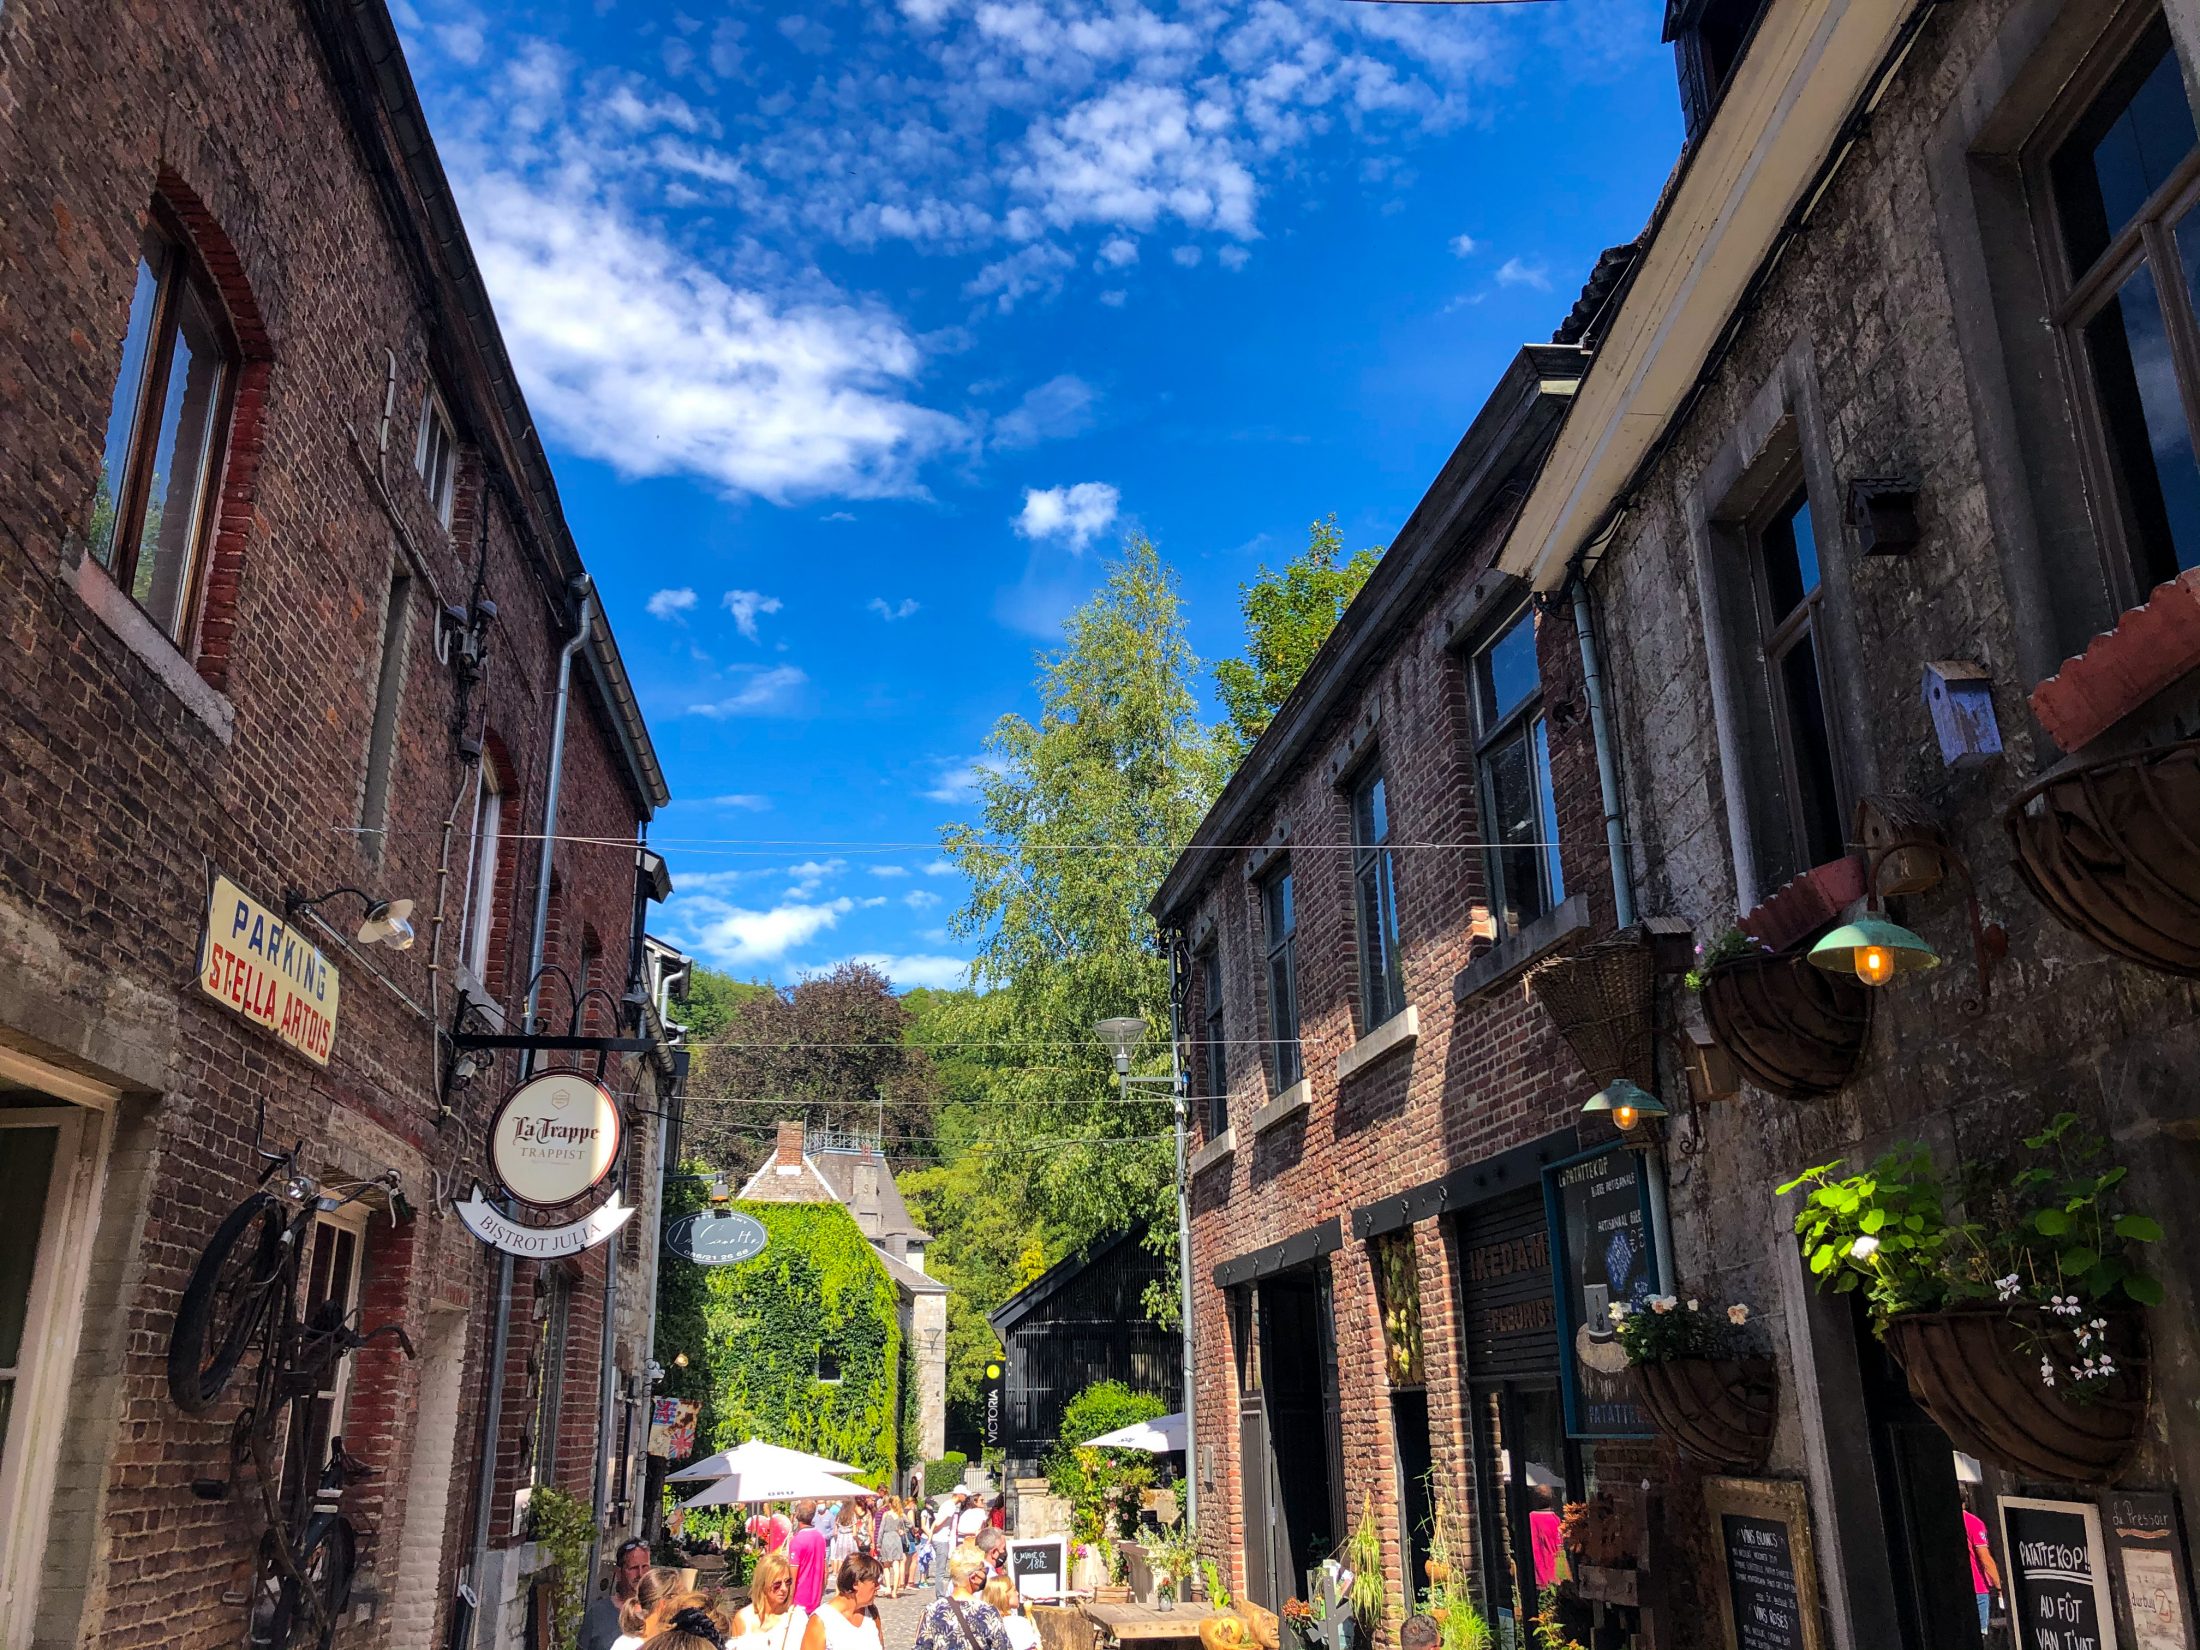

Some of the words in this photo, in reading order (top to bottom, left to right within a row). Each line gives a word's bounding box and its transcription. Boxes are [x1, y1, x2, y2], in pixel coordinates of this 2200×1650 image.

[232, 900, 326, 1001] PARKING
[209, 943, 276, 1023] STELLA
[280, 992, 331, 1058] ARTOIS
[512, 1116, 535, 1142] La
[536, 1117, 600, 1144] Trappe
[520, 1147, 586, 1160] TRAPPIST
[480, 1215, 548, 1251] BISTROT
[552, 1223, 602, 1251] JULIA
[688, 1214, 748, 1225] RESTANT
[988, 1388, 998, 1443] VICTORIA
[1026, 1558, 1047, 1570] 18h
[2040, 1594, 2054, 1619] AU
[2058, 1591, 2083, 1624] FÛT
[2036, 1627, 2059, 1650] VAN
